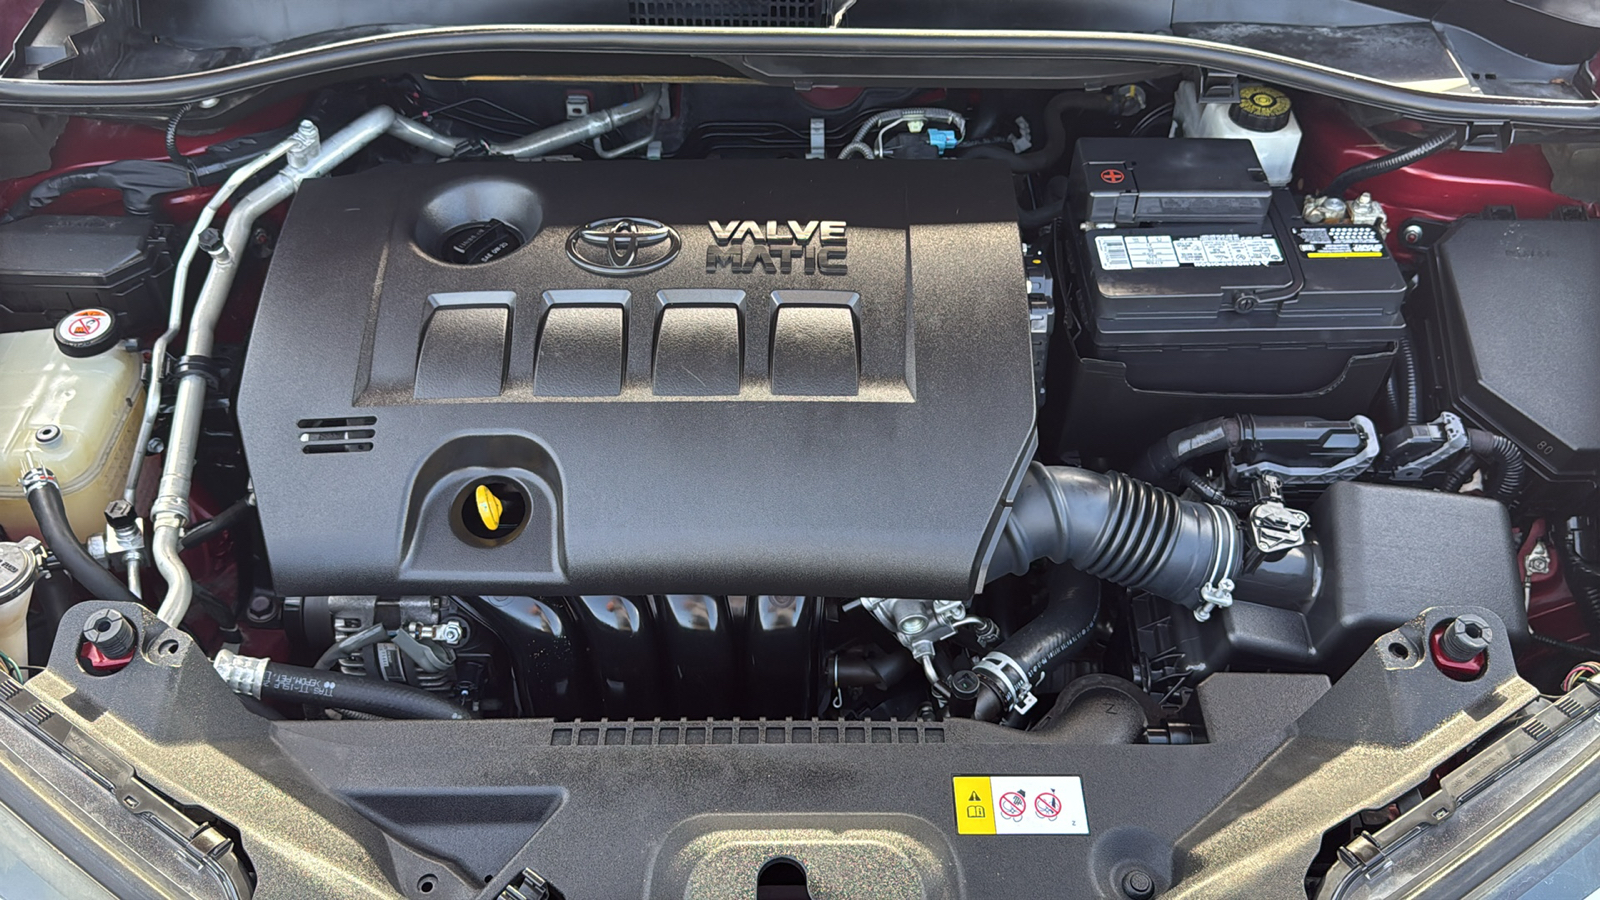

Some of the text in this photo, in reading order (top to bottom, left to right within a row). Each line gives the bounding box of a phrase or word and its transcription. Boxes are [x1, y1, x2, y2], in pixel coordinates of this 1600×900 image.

[708, 220, 847, 246] VALVE
[481, 252, 493, 262] SAE
[706, 244, 848, 276] MATIC
